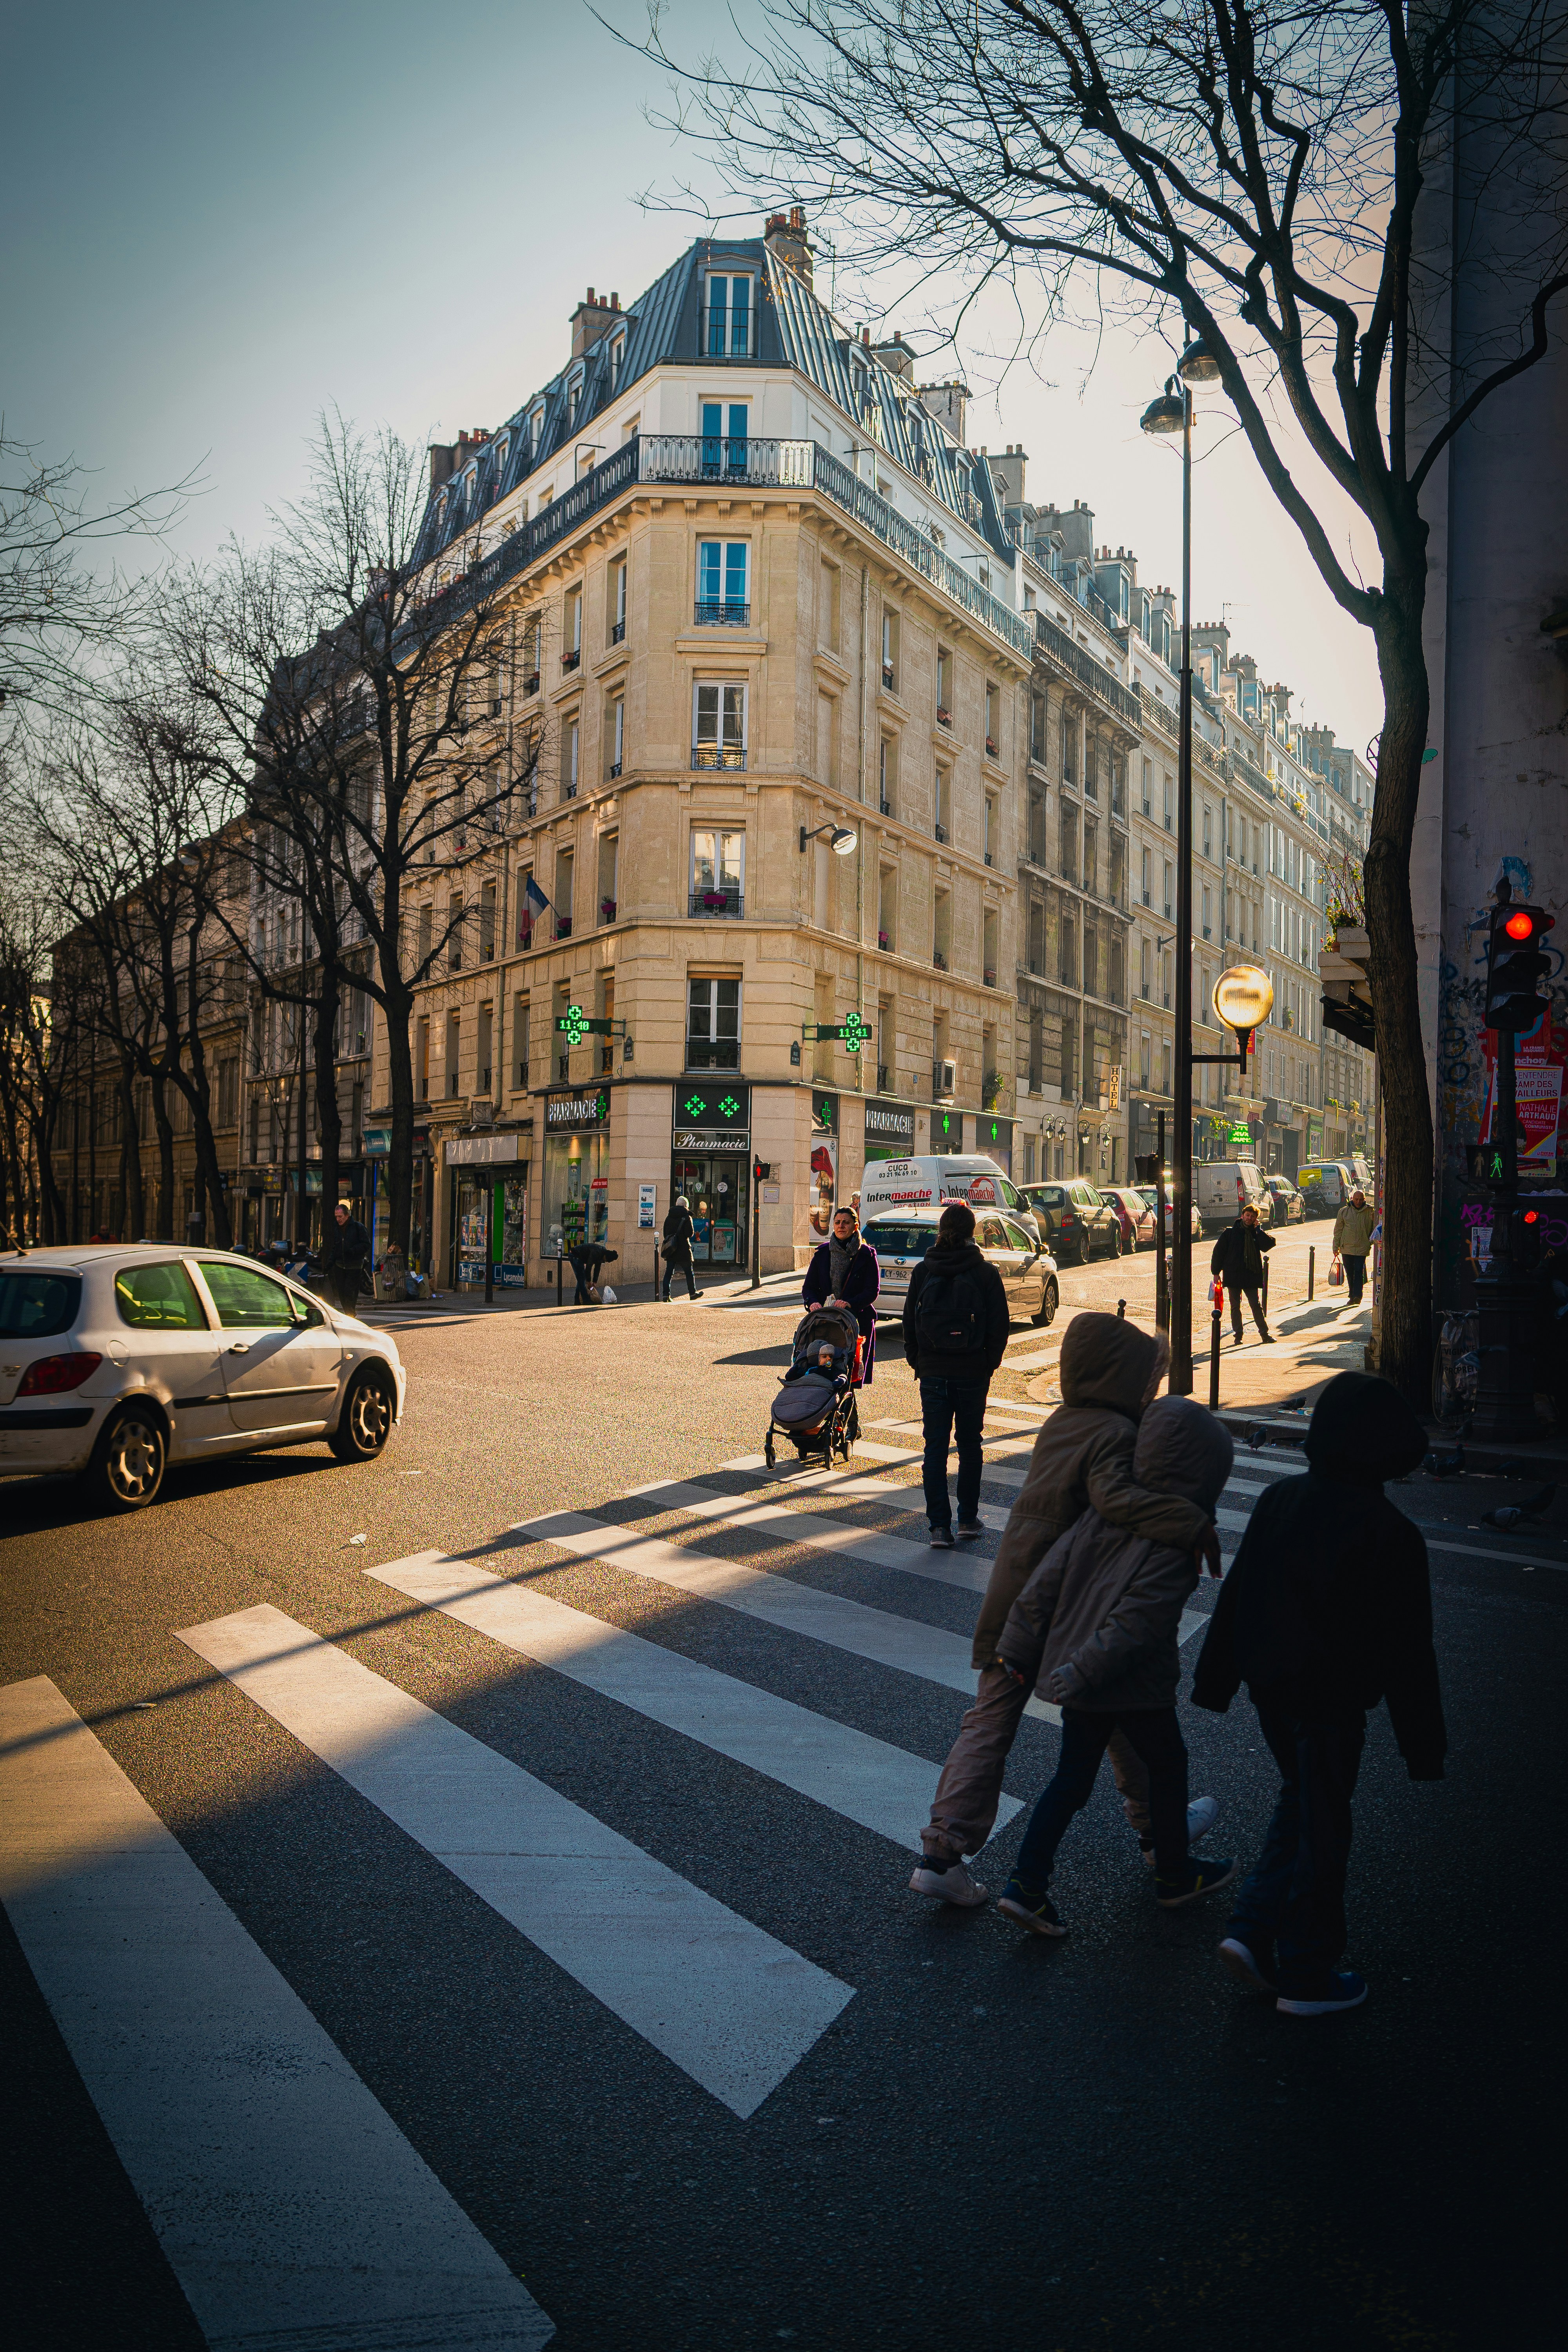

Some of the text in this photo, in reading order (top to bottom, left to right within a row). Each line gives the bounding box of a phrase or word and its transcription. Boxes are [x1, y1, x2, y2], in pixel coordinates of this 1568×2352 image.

[560, 1020, 589, 1031] 11:40
[839, 1028, 868, 1038] 11:41
[549, 1099, 597, 1121] PHARMACIE
[1519, 1103, 1557, 1113] NATHALIE
[1519, 1111, 1555, 1120] ARTHAUD
[866, 1110, 913, 1134] PHARMACIE
[677, 1133, 746, 1148] Pharmacie
[867, 1189, 932, 1204] Intermarché
[504, 1272, 524, 1283] Lycamobile
[885, 1270, 912, 1278] CY-962-
